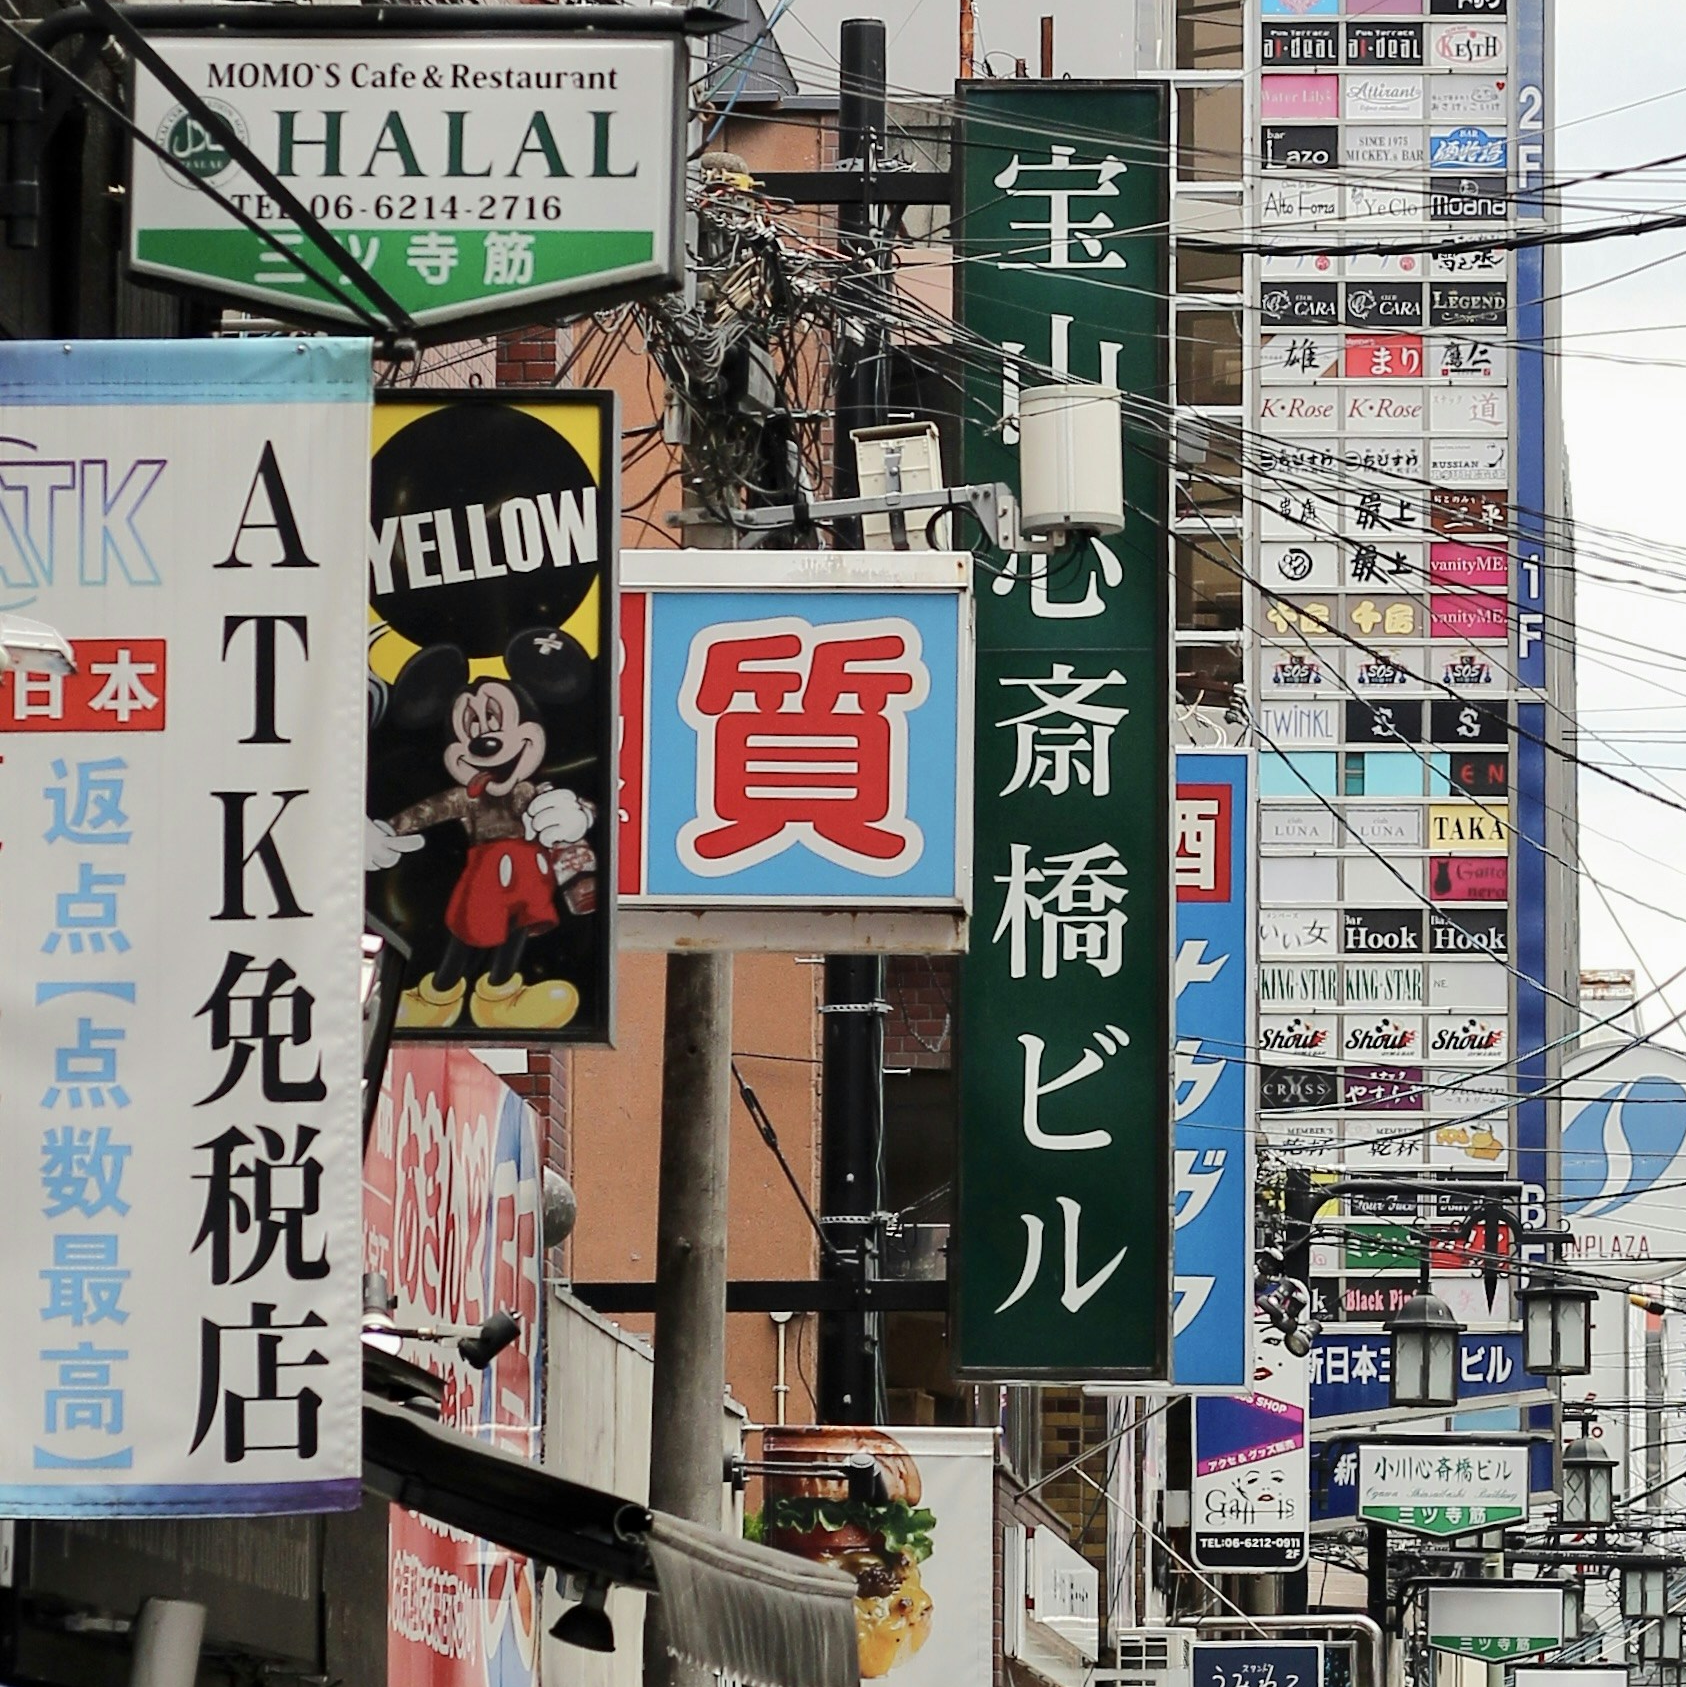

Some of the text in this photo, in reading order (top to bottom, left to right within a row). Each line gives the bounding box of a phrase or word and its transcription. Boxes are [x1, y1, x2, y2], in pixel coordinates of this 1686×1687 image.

[351, 62, 417, 89] Cafe
[423, 68, 443, 89] &
[452, 63, 619, 91] Restaurant
[271, 110, 639, 178] HALAL
[1267, 129, 1286, 140] bar
[1359, 137, 1408, 147] SINCE 1975
[1266, 140, 1329, 169] Lazo
[1402, 150, 1424, 161] BAR
[311, 195, 562, 221] 06-6214-2716
[255, 231, 535, 285] 三ツ寺筋
[1294, 303, 1335, 316] CARA
[1380, 303, 1421, 316] CARA
[1433, 291, 1505, 310] LEGEND
[1371, 347, 1419, 375] まり
[1469, 393, 1503, 426] 道
[1432, 461, 1479, 469] RUSSIAN
[368, 485, 599, 596] YELLOW
[1283, 665, 1309, 677] SOS
[1368, 665, 1394, 677] SOS
[1453, 665, 1480, 677] SOS
[684, 625, 924, 868] 質
[1275, 826, 1319, 836] LUNA
[1361, 826, 1405, 836] LUNA
[1434, 817, 1505, 840] TAKA
[1346, 926, 1418, 950] Hook
[1435, 927, 1506, 950] Hook
[1345, 1289, 1384, 1312] Black
[1256, 1398, 1288, 1415] SHOP
[1397, 1505, 1487, 1525] 三ツ寺筋
[1285, 1549, 1301, 1560] 2F
[1459, 1637, 1531, 1652] 三ツ寺筋
